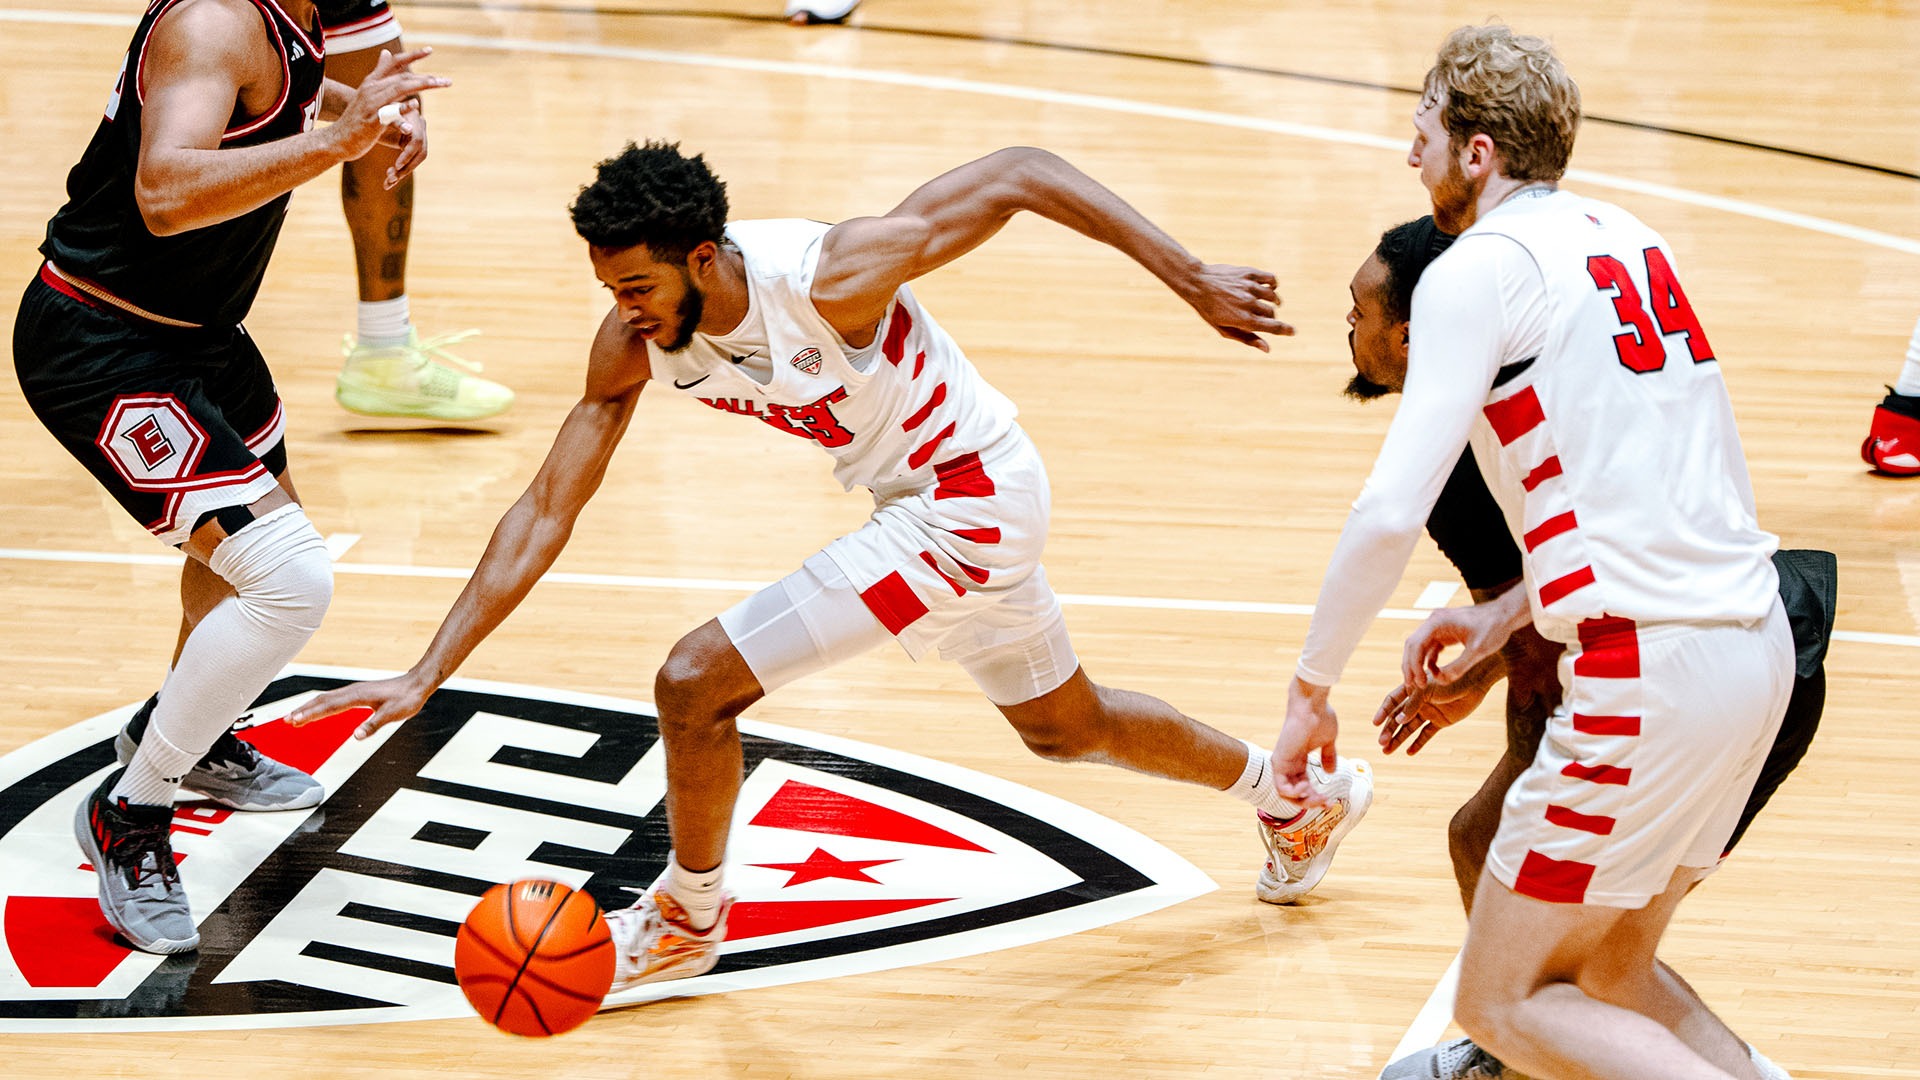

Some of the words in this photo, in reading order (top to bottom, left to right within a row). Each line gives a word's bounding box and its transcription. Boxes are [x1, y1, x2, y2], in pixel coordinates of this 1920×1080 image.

[1586, 246, 1717, 375] 34
[120, 413, 177, 472] E
[209, 711, 668, 1008] MAC
